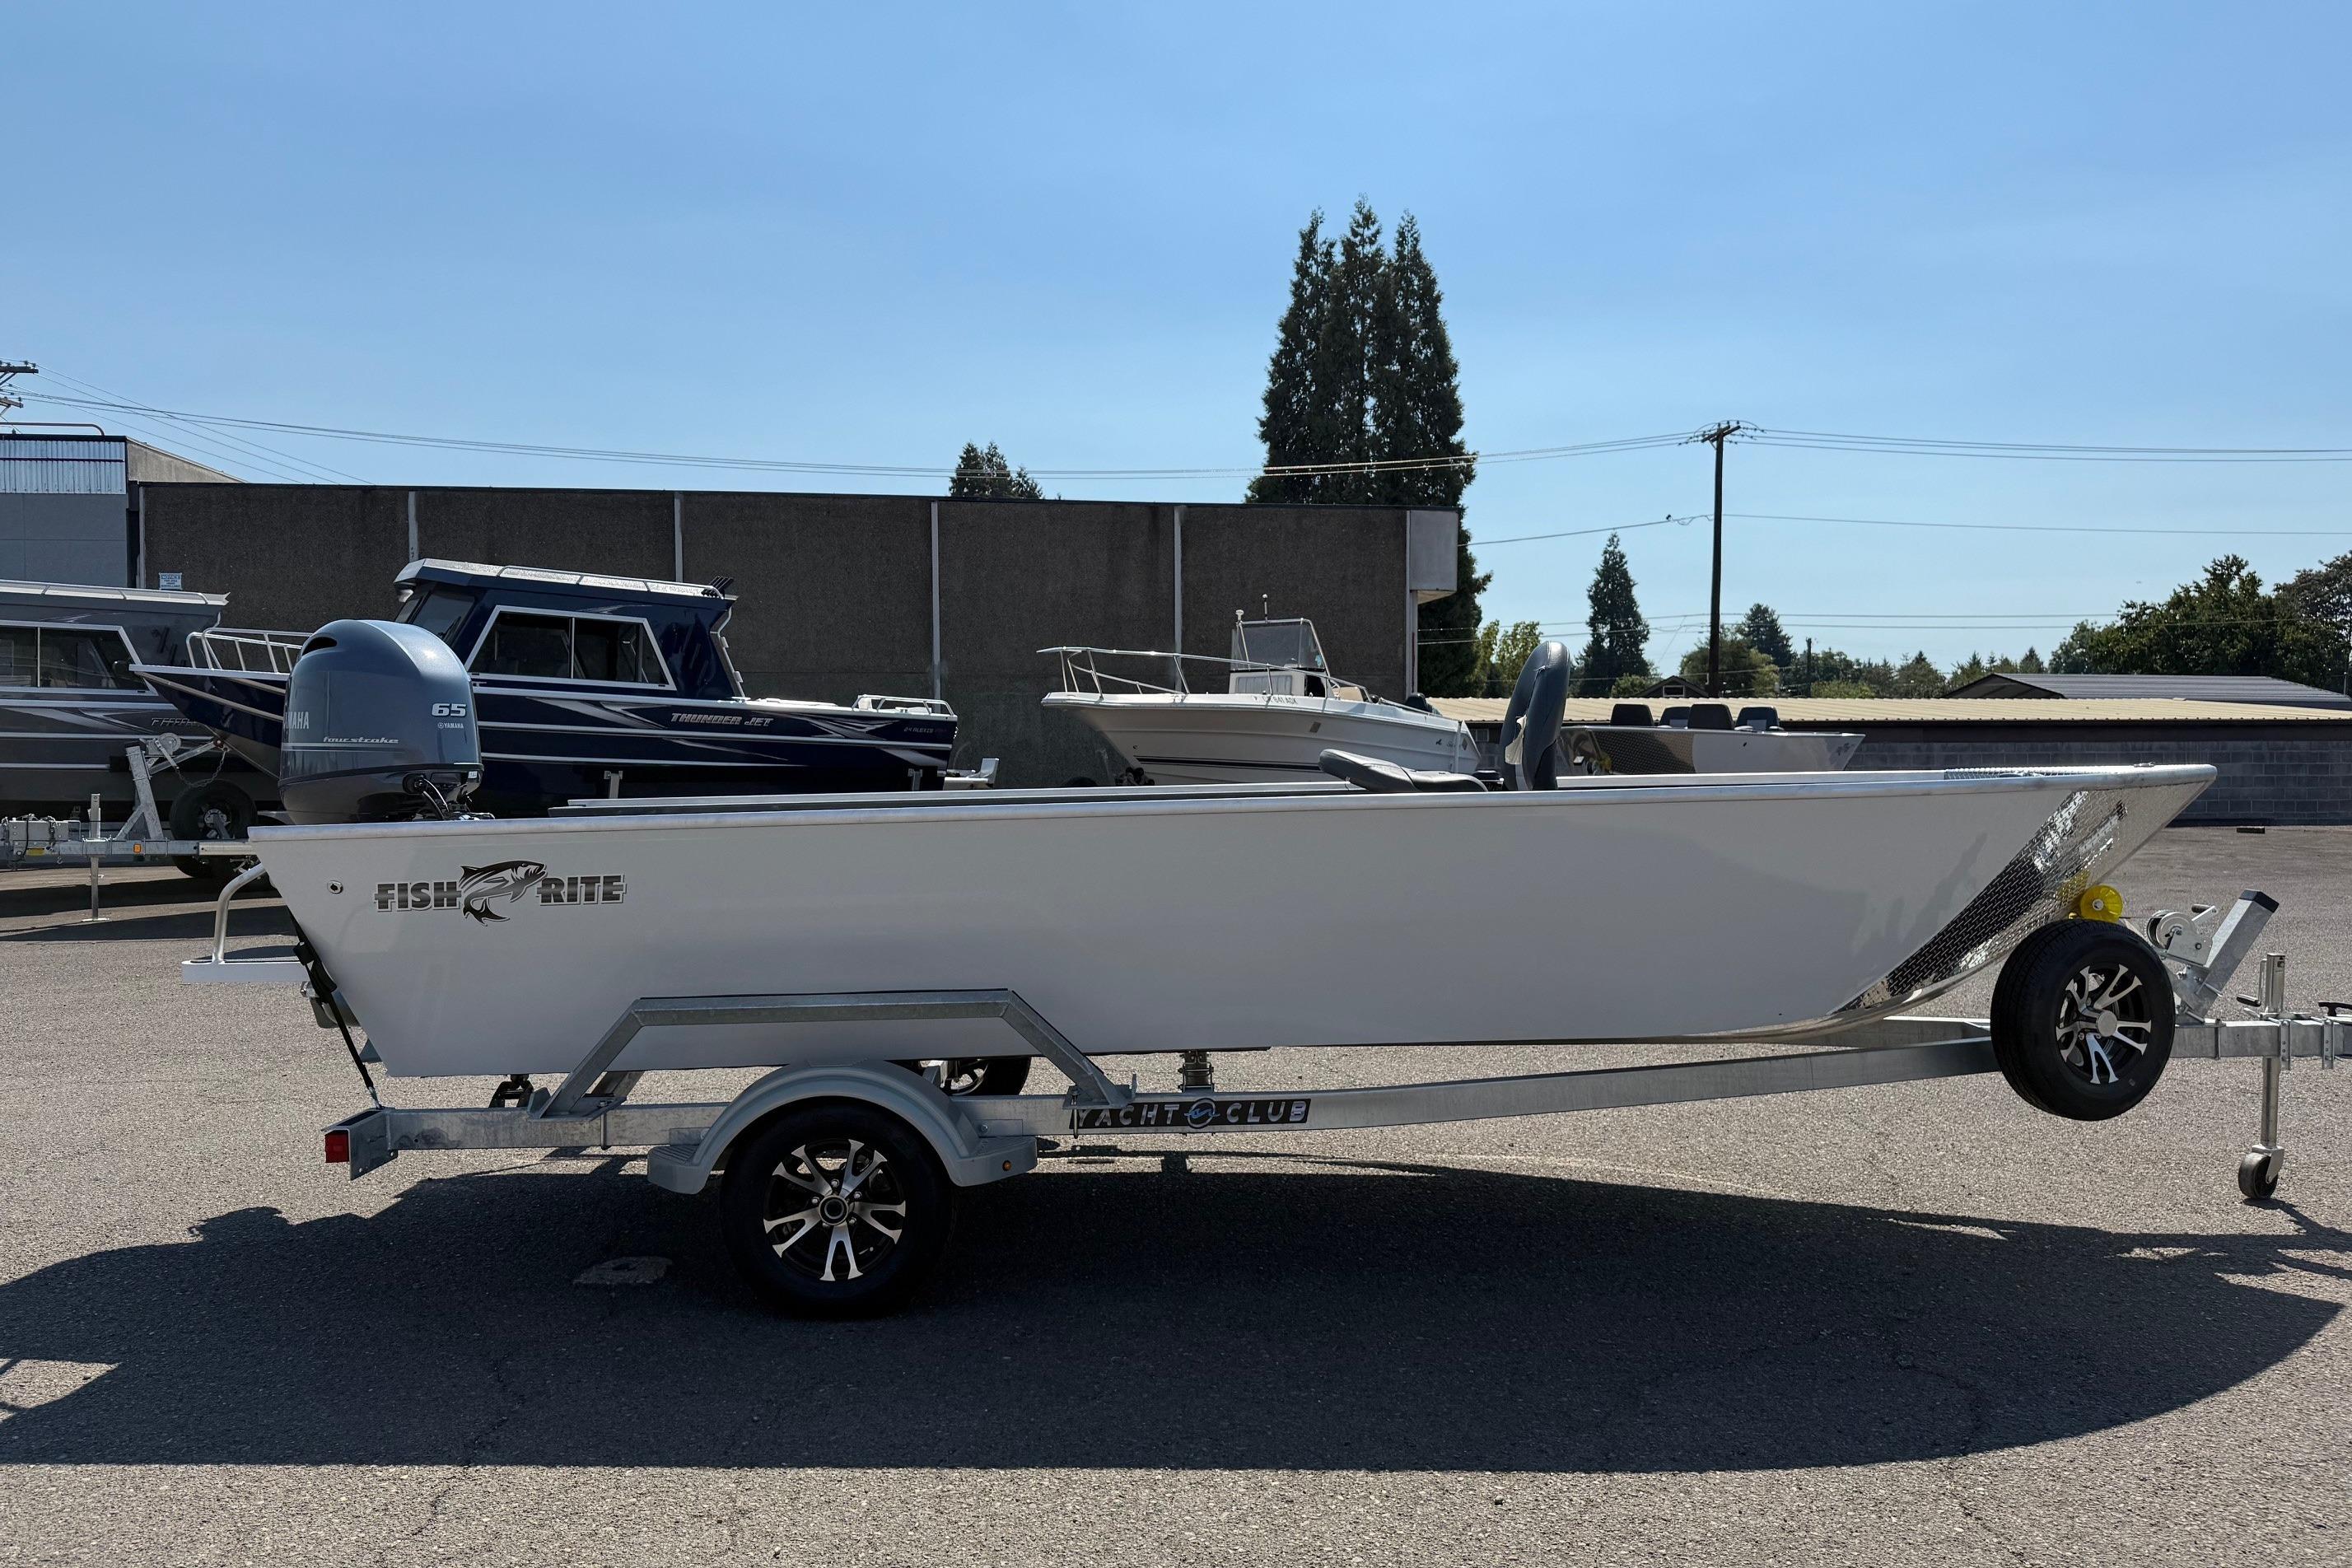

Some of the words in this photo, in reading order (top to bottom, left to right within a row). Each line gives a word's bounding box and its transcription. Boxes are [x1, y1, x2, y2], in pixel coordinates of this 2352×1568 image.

[432, 702, 467, 716] 65
[670, 712, 743, 726] THUNDER
[744, 716, 774, 727] JET
[374, 880, 463, 912] FISH
[535, 875, 627, 906] RITE
[1076, 1104, 1178, 1128] YACHT
[1225, 1100, 1304, 1127] CLUB
